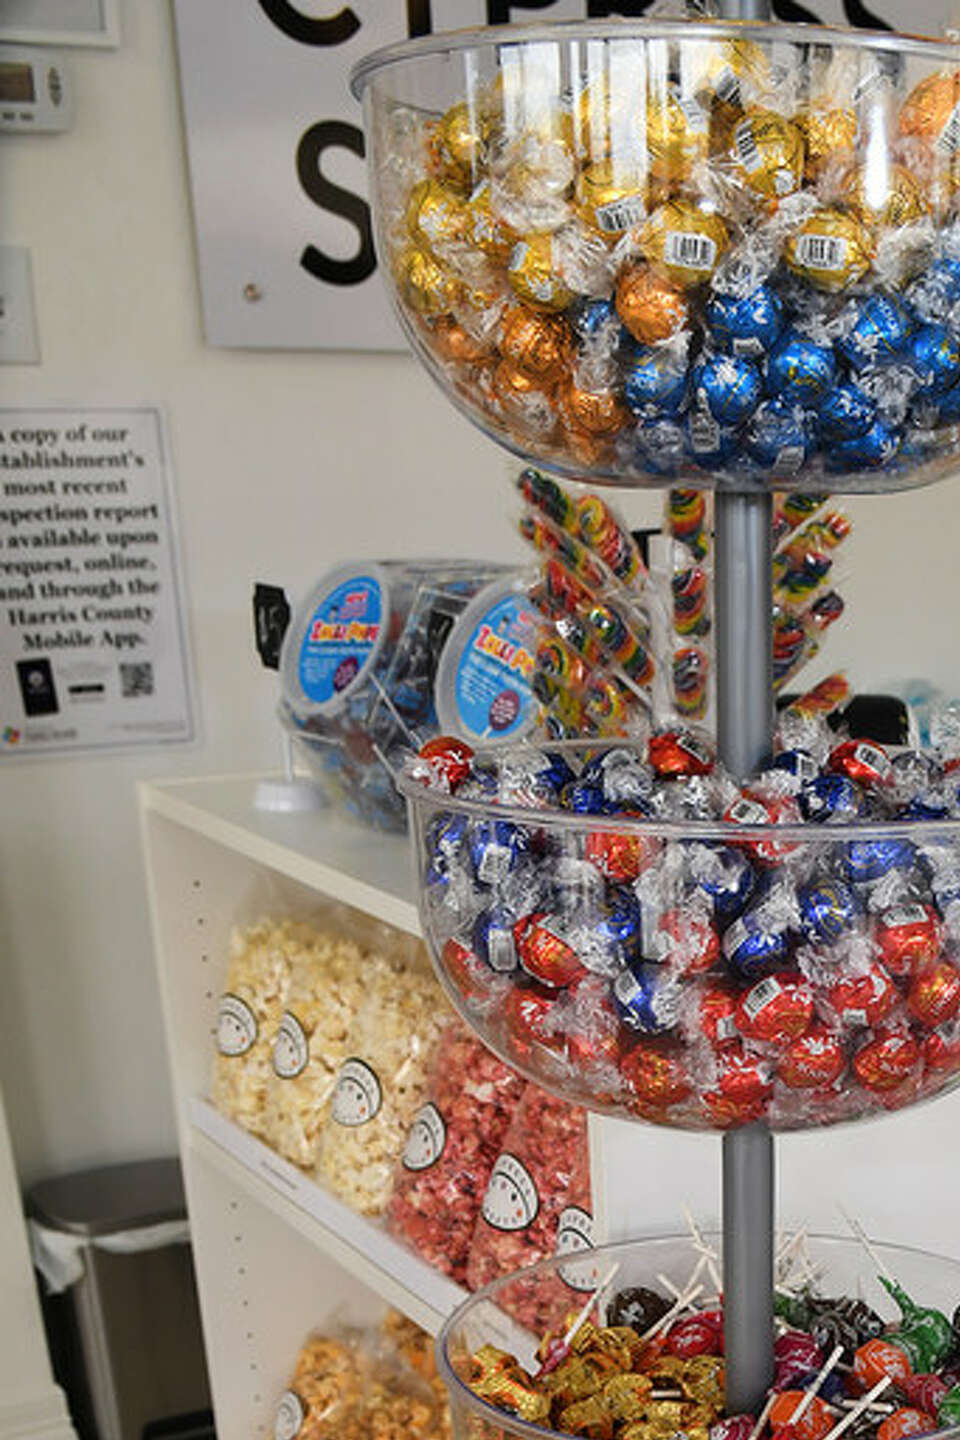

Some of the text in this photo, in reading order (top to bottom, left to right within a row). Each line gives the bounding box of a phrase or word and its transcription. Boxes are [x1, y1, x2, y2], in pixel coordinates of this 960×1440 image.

[10, 424, 128, 446] copy of our
[0, 450, 144, 468] tablishment's
[4, 478, 127, 496] most recent
[0, 504, 158, 526] spection report
[8, 529, 158, 549] available upon
[84, 554, 157, 571] online,
[40, 579, 122, 599] through
[128, 579, 158, 595] the
[8, 605, 152, 626] Harris County
[23, 631, 93, 650] Mobile
